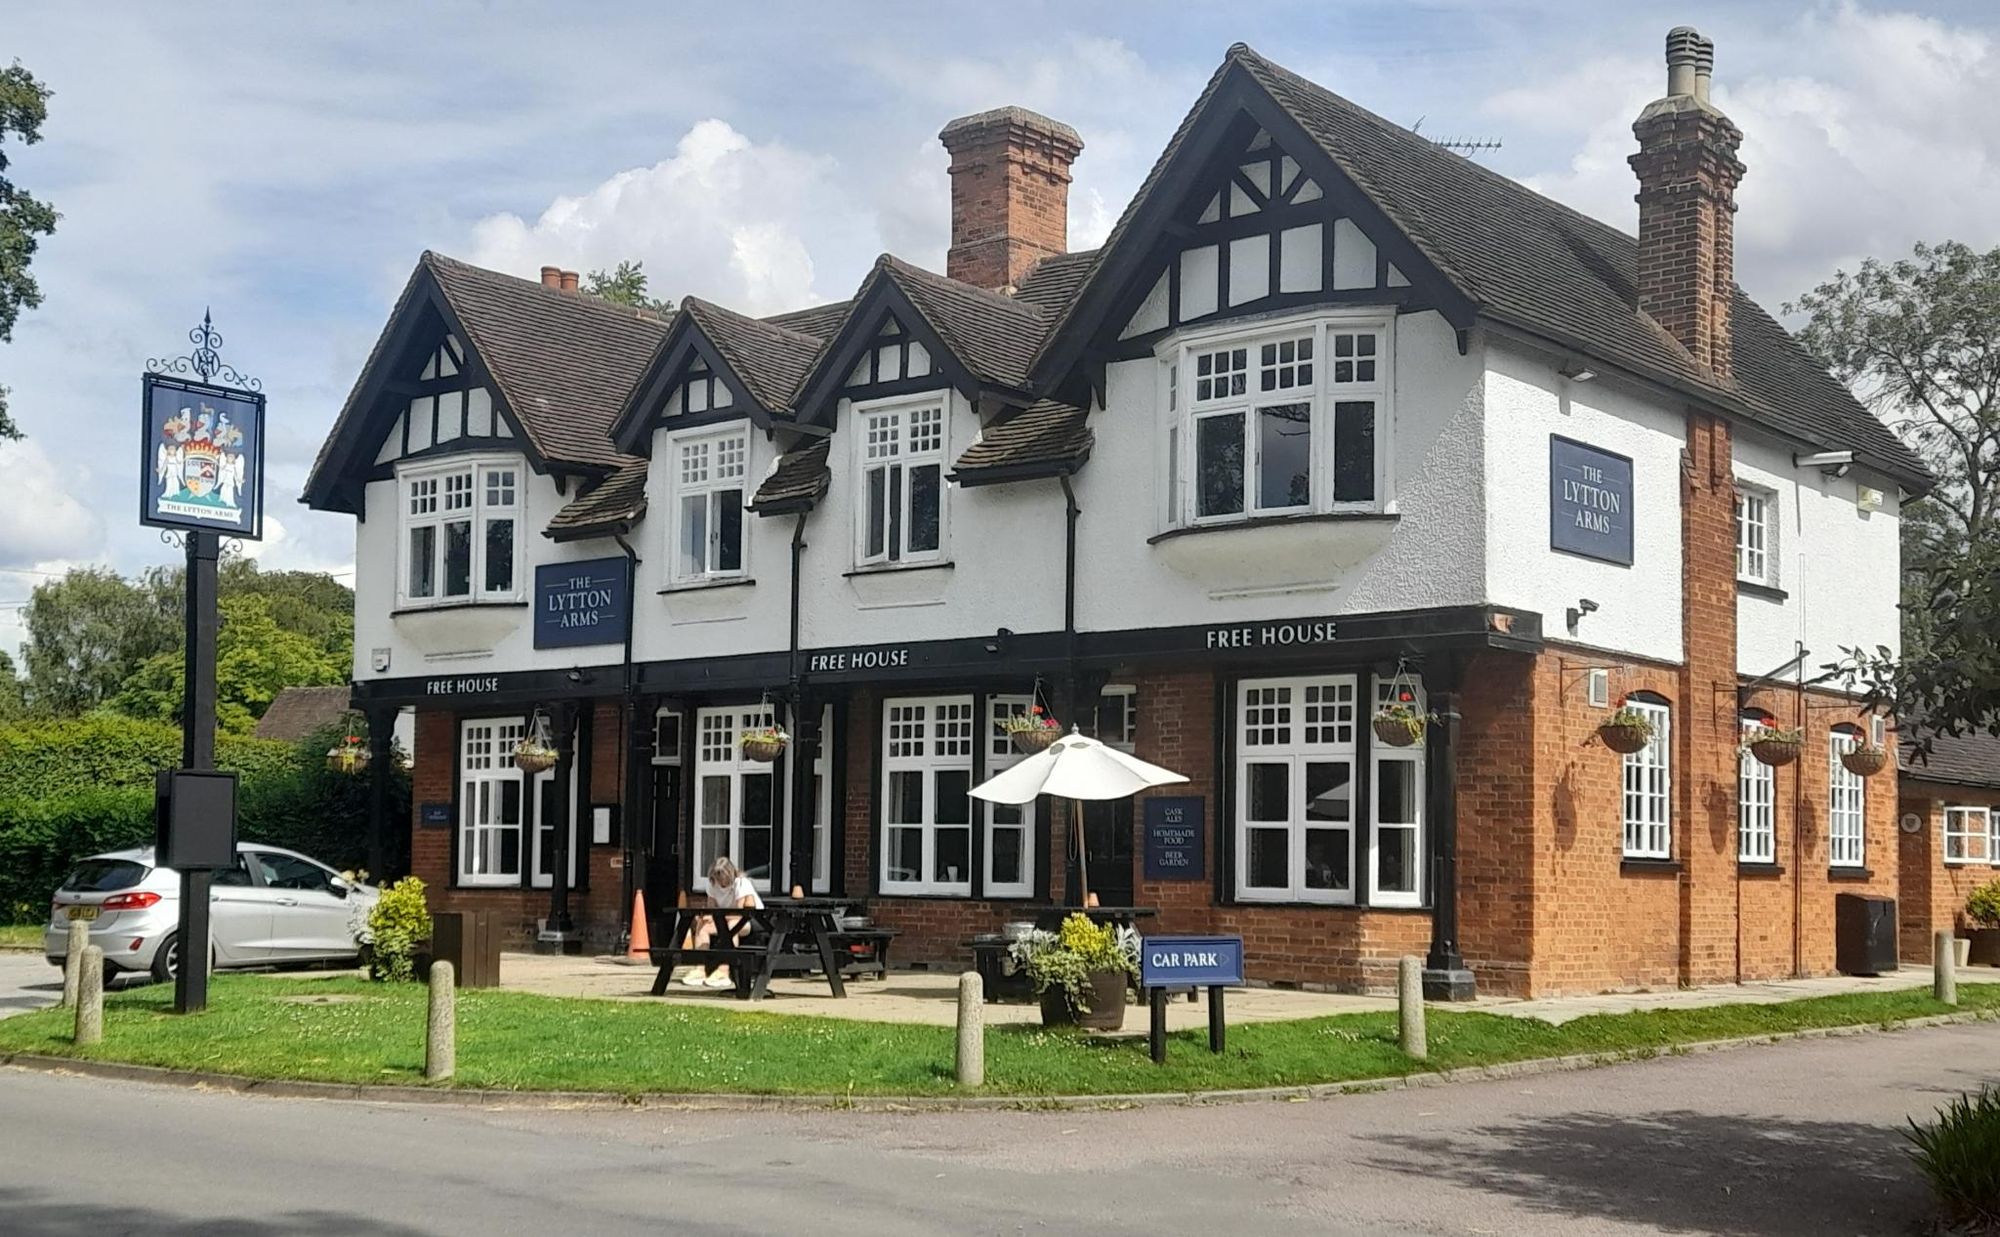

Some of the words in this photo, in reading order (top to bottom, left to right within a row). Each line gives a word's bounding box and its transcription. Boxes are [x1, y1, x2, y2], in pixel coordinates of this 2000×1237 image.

[1582, 465, 1602, 483] THE
[1563, 479, 1619, 514] LYTTON
[166, 503, 181, 512] THE
[214, 510, 234, 518] ARMS
[1575, 509, 1609, 534] ARMS
[568, 576, 591, 590] THE
[548, 589, 611, 612] LYTTON
[560, 610, 599, 628] ARMS
[1206, 628, 1252, 649] FREE
[1261, 622, 1336, 645] HOUSE
[811, 654, 845, 671] FREE
[851, 650, 908, 668] HOUSE
[427, 680, 453, 695] FREE
[457, 678, 498, 693] HOUSE
[1165, 808, 1183, 816] CASK
[1153, 829, 1195, 838] HOMEMADE
[1164, 837, 1184, 845] FOOD
[1159, 858, 1189, 867] GARDEN
[1165, 851, 1183, 859] BEER
[1152, 953, 1180, 967] CAR
[1183, 952, 1218, 967] PARK
